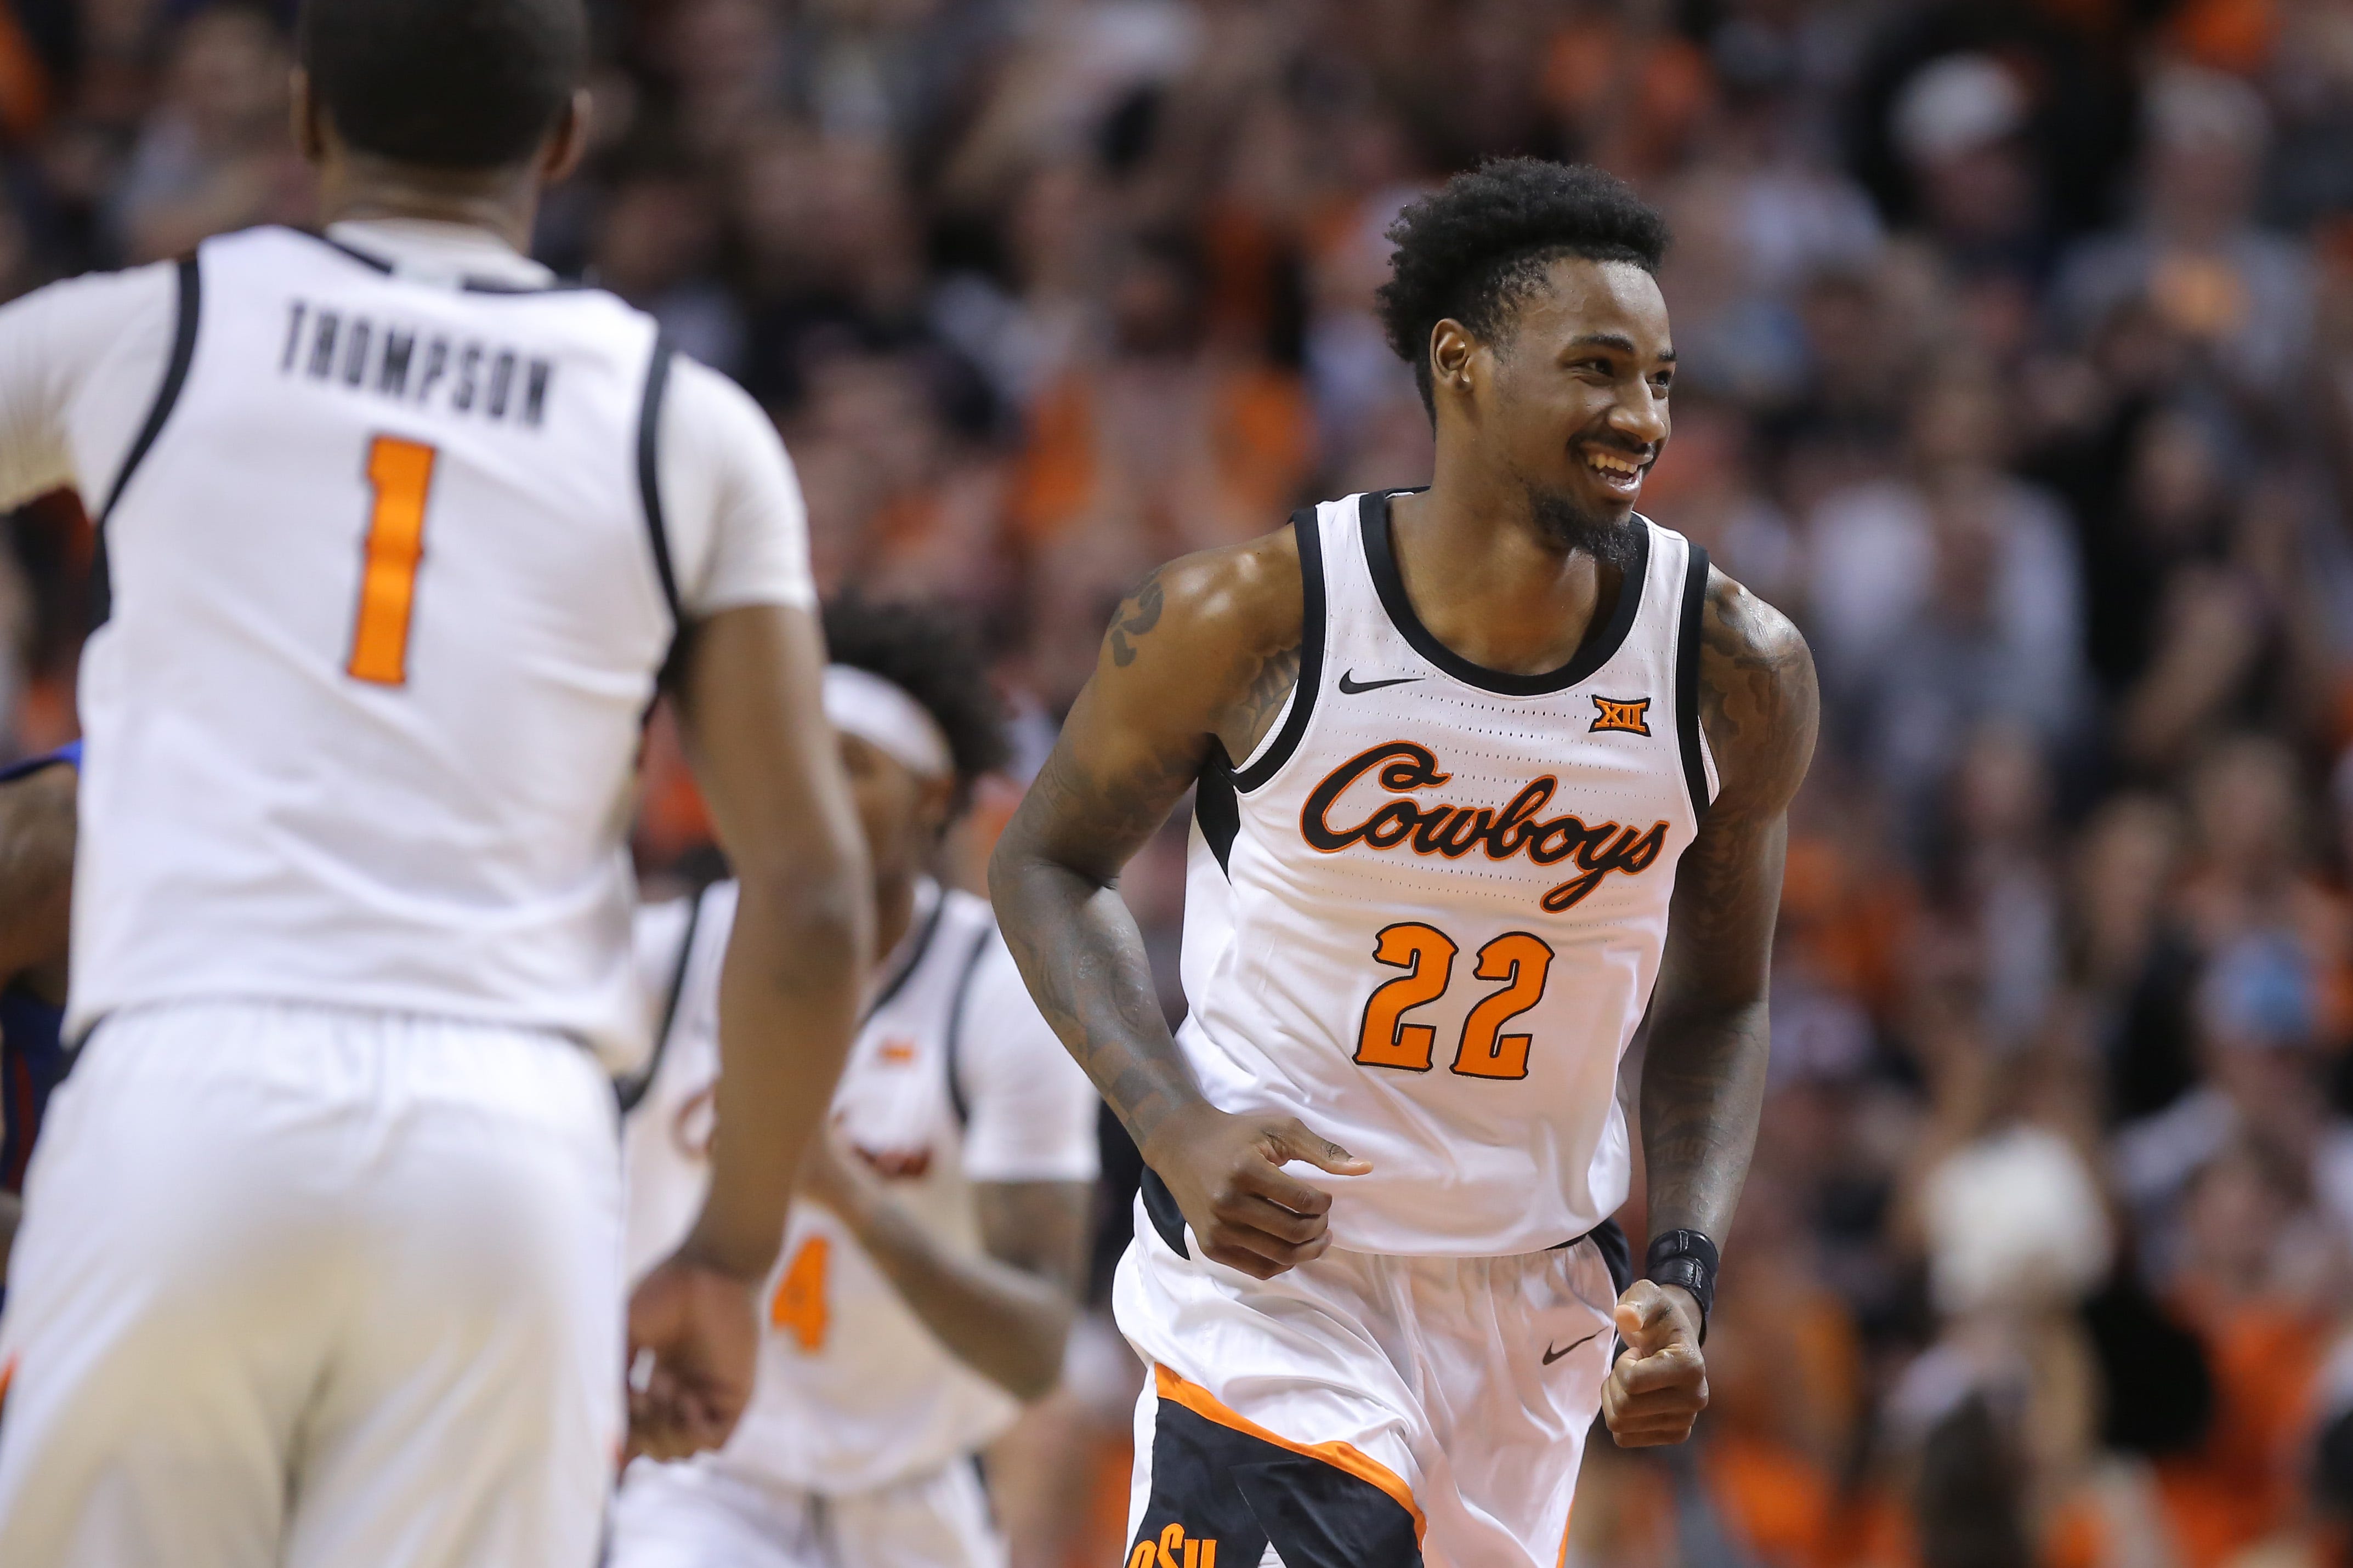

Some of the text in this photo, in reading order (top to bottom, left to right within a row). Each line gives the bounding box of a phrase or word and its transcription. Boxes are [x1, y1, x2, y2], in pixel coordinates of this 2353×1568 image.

[344, 434, 436, 688] 1
[1594, 698, 1647, 732] XII
[1299, 741, 1670, 913] Cowboys
[1352, 922, 1555, 1080] 22
[771, 1232, 832, 1353] 4
